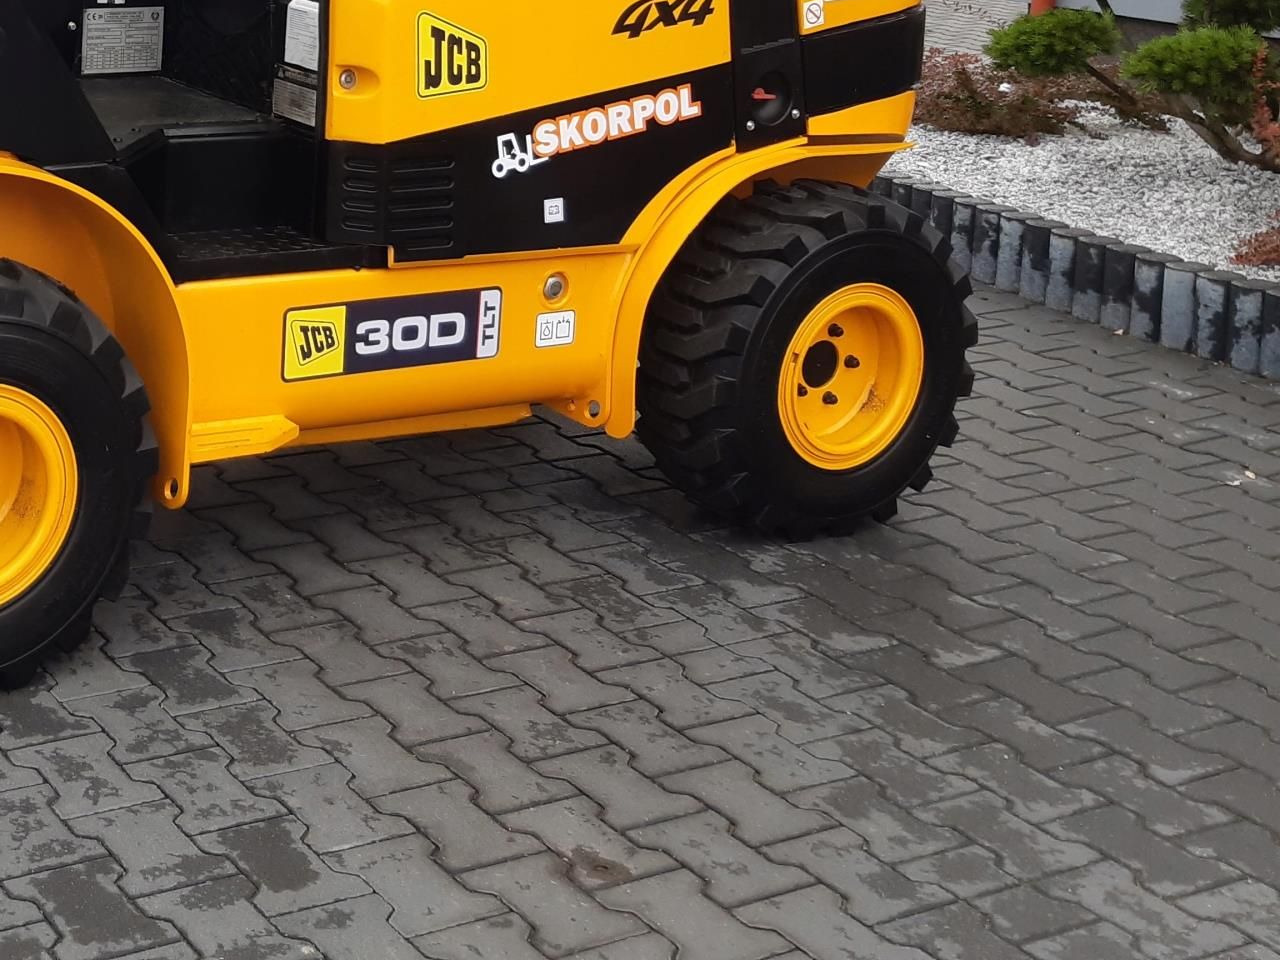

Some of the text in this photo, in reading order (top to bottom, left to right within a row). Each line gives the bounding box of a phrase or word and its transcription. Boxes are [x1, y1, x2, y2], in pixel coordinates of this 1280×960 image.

[423, 25, 482, 90] JCB
[532, 83, 702, 158] SKORPOL
[298, 311, 466, 361] JCB 30D
[481, 300, 497, 347] TLT
